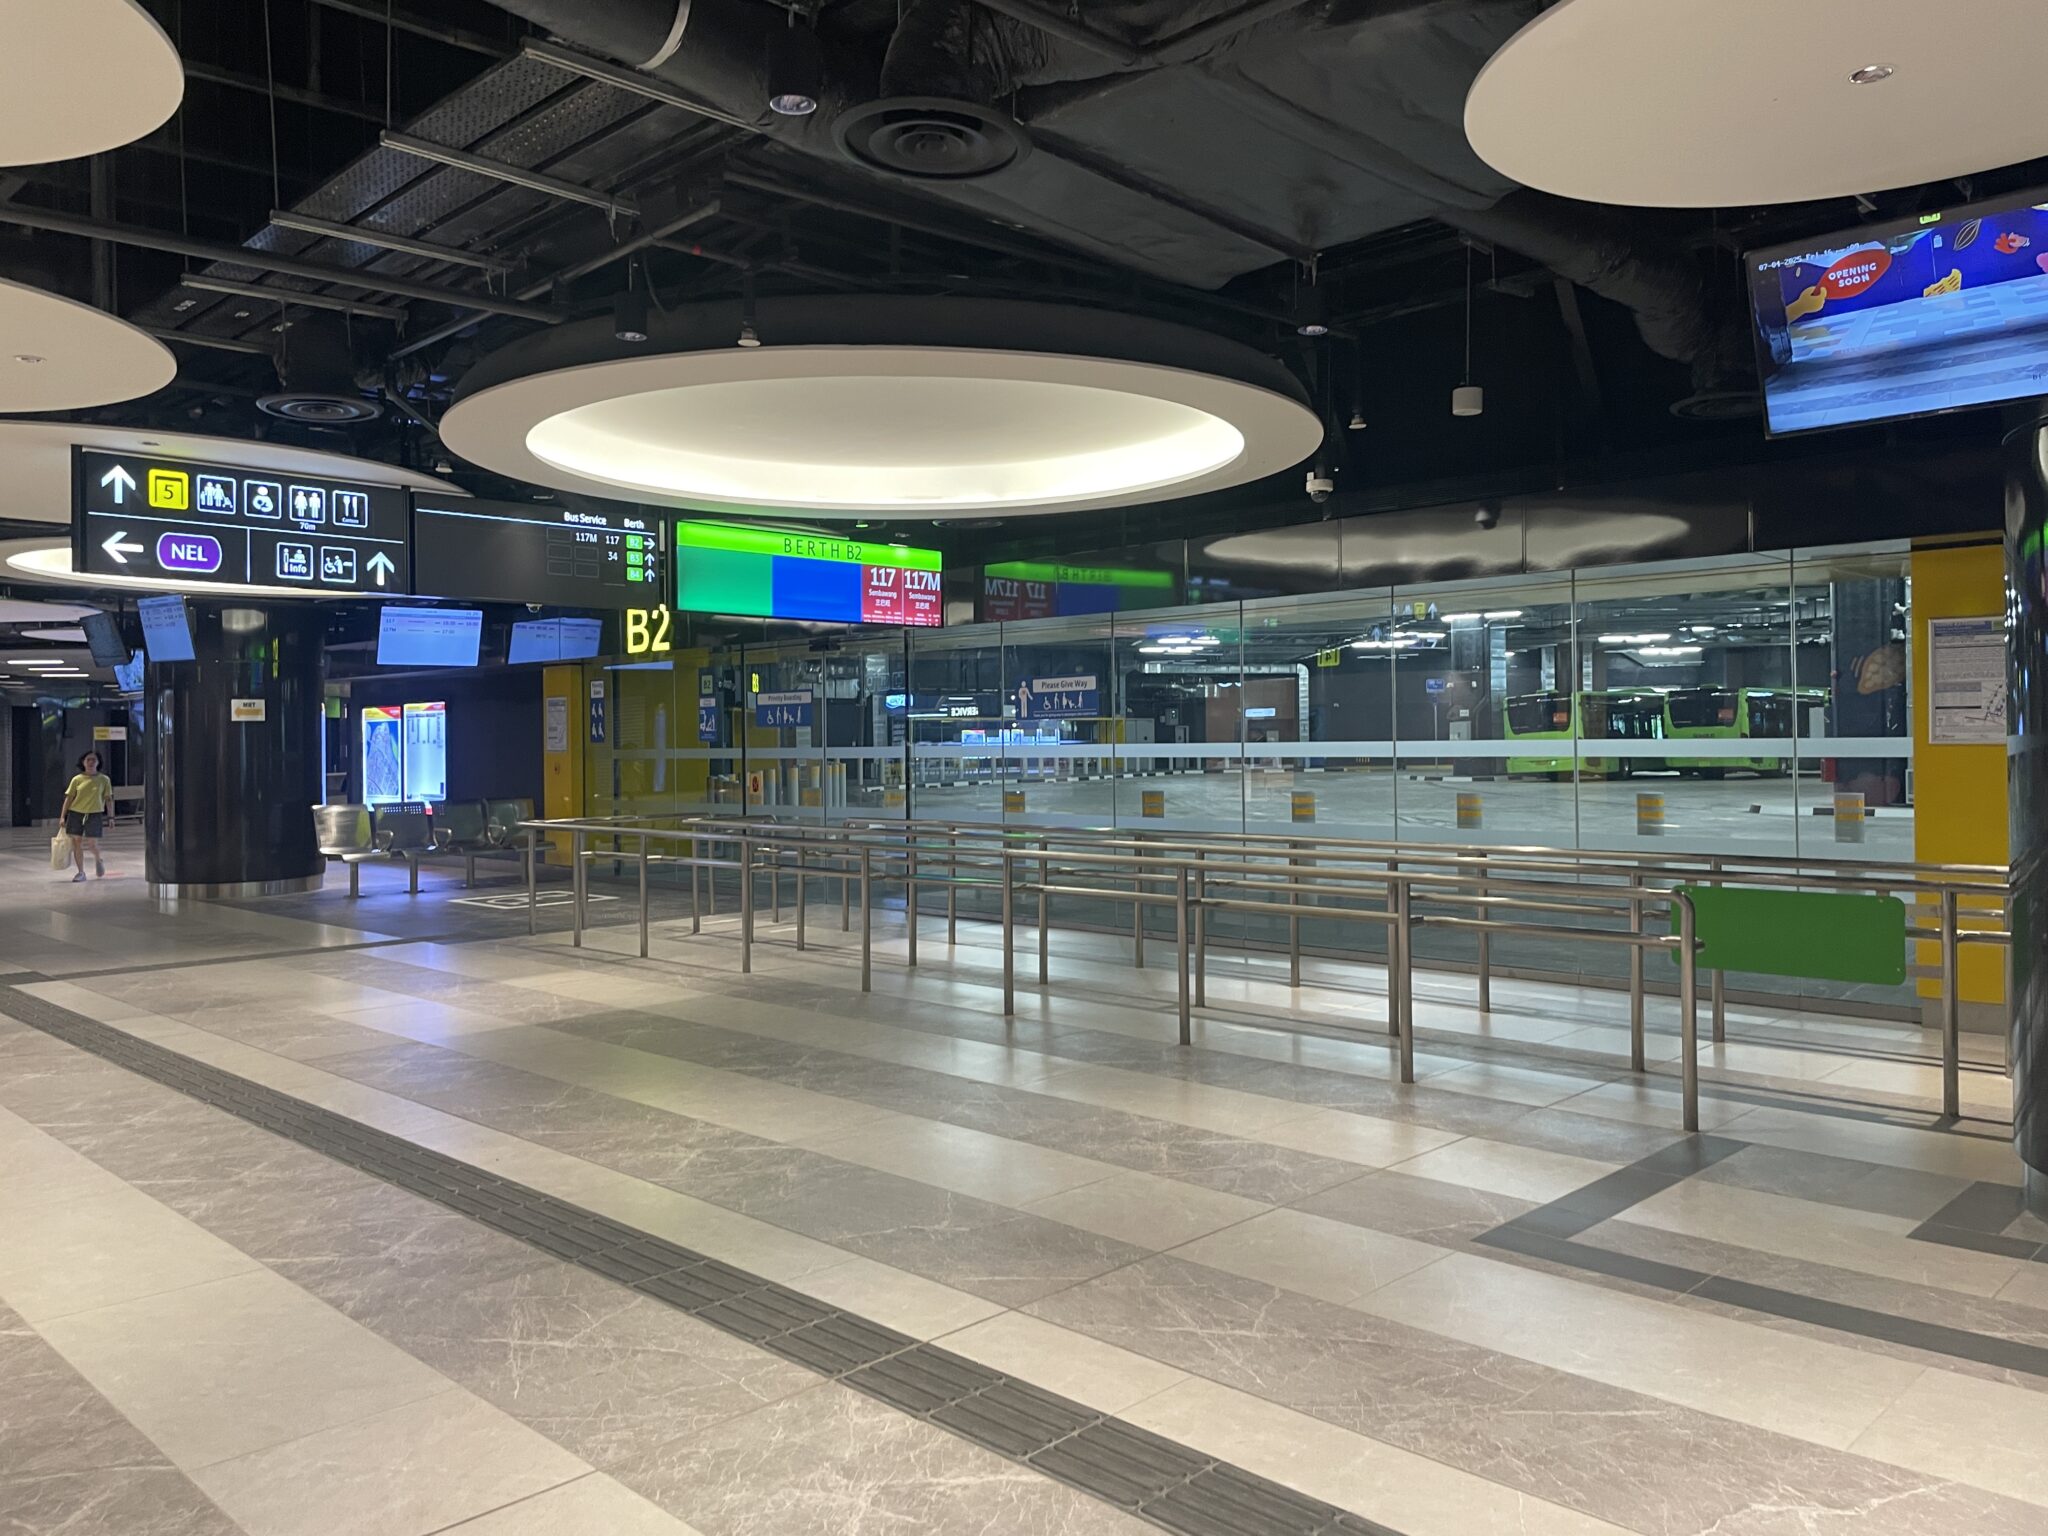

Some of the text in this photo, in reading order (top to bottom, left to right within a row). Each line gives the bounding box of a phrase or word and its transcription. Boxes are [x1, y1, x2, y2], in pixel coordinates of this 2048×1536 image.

[1828, 262, 1877, 281] OPENING
[1838, 273, 1870, 287] SOON
[163, 484, 174, 500] 5
[563, 511, 608, 526] Bus Service
[624, 518, 645, 529] Berth
[299, 521, 316, 531] 70m
[575, 532, 598, 543] 117M
[605, 535, 620, 545] 117
[171, 542, 208, 562] NEL
[784, 537, 862, 561] BERTH B2
[607, 551, 618, 561] 34
[289, 562, 307, 574] Info
[870, 567, 896, 587] 117
[904, 570, 940, 591] 117M
[868, 588, 897, 599] Sembawang
[908, 591, 936, 602] Sembawang
[627, 604, 671, 654] B2
[1041, 680, 1088, 689] Please Give Way
